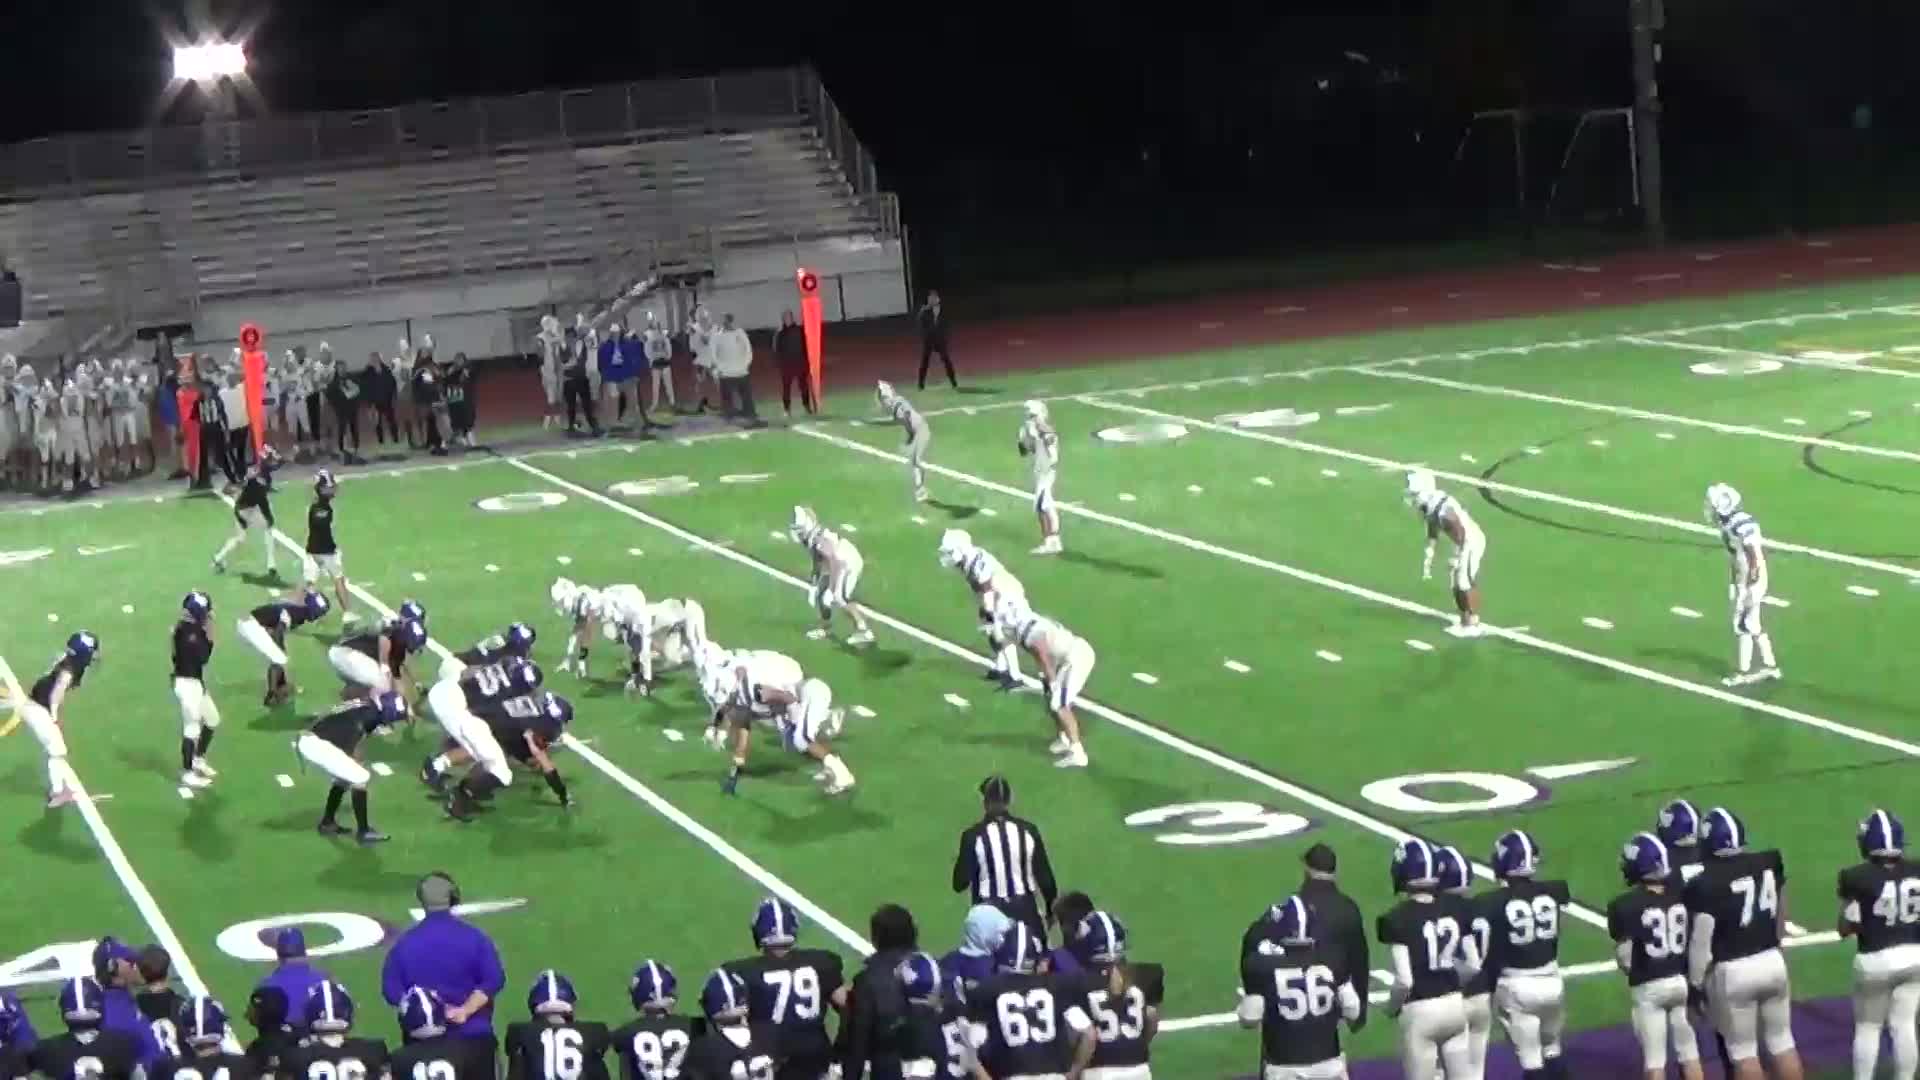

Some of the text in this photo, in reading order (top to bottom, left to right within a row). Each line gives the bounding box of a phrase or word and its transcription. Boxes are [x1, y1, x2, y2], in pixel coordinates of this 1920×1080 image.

[1505, 895, 1558, 945] 99
[1729, 869, 1777, 927] 74
[1872, 876, 1920, 926] 46
[1422, 916, 1460, 970] 12
[1640, 903, 1688, 958] 38
[763, 966, 821, 1025] 79
[997, 988, 1057, 1047] 63
[1087, 986, 1145, 1041] 53
[1274, 965, 1335, 1021] 56
[540, 1028, 584, 1080] 16
[633, 1029, 690, 1080] 92
